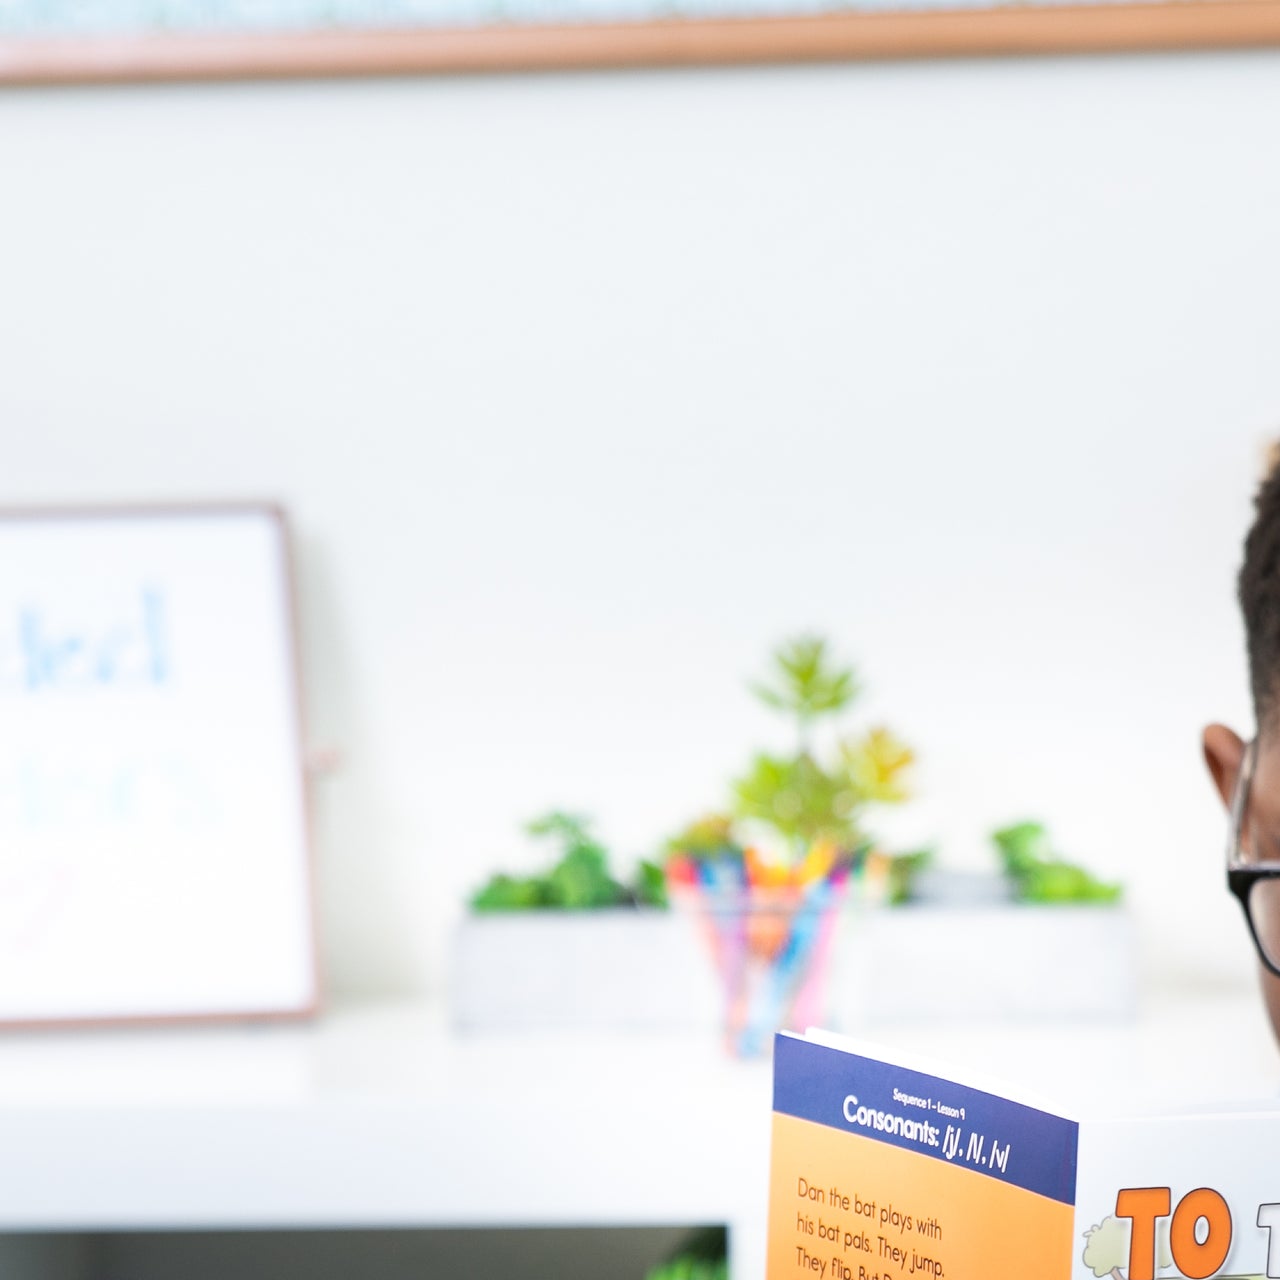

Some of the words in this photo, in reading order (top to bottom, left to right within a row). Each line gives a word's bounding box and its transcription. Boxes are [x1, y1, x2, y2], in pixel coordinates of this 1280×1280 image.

[842, 1094, 940, 1147] Consonants:
[892, 1087, 928, 1109] Sequence
[936, 1100, 962, 1119] Lesson
[797, 1177, 825, 1204] Dan
[829, 1187, 850, 1212] the
[854, 1194, 877, 1219] bat
[879, 1204, 913, 1235] plays
[916, 1217, 942, 1241] with
[795, 1245, 828, 1280] They
[796, 1211, 815, 1236] his
[818, 1218, 841, 1243] bat
[843, 1231, 873, 1254] pals.
[877, 1235, 908, 1271] They
